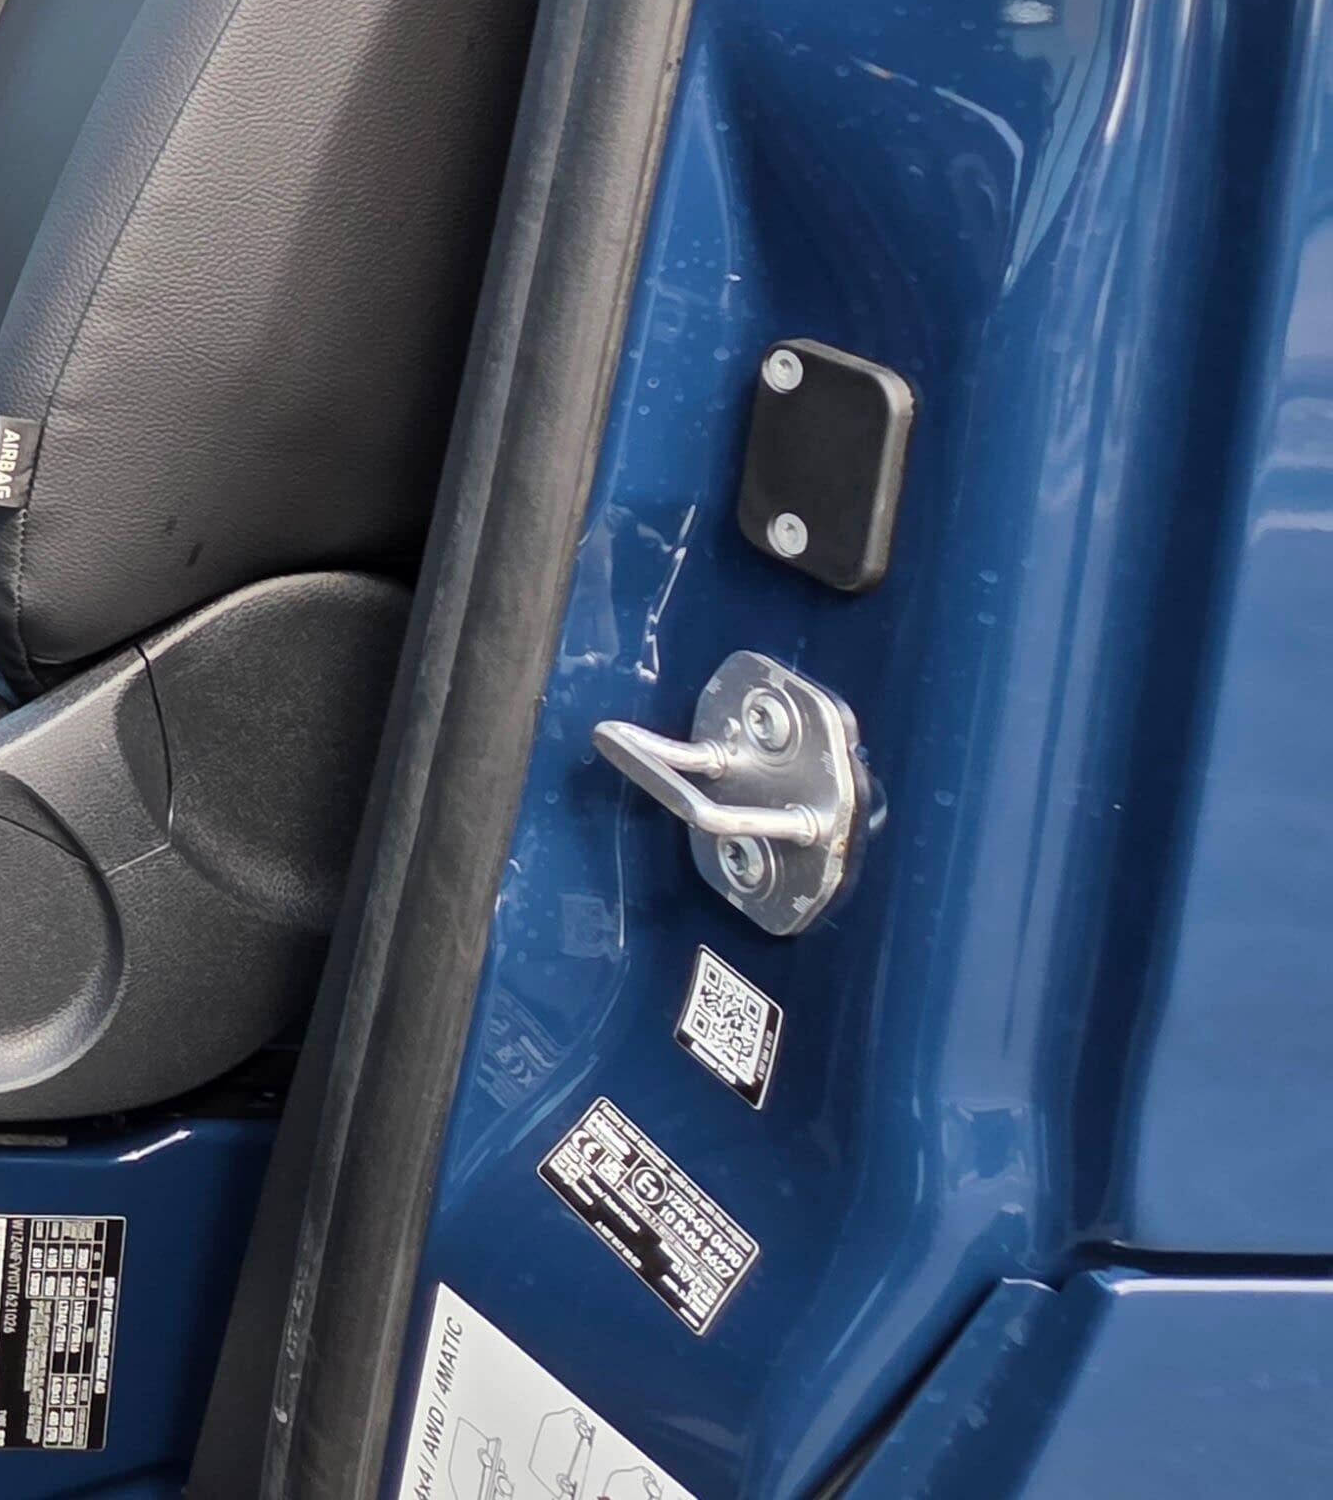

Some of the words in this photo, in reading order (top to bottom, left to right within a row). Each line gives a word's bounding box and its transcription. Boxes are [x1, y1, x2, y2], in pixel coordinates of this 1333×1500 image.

[568, 1127, 601, 1161] CE
[657, 1204, 676, 1225] 10
[699, 1245, 735, 1283] 5627
[664, 1189, 713, 1239] 122R-00
[708, 1232, 743, 1269] 0490
[422, 1404, 445, 1460] AWD
[435, 1317, 463, 1395] 4MATIC
